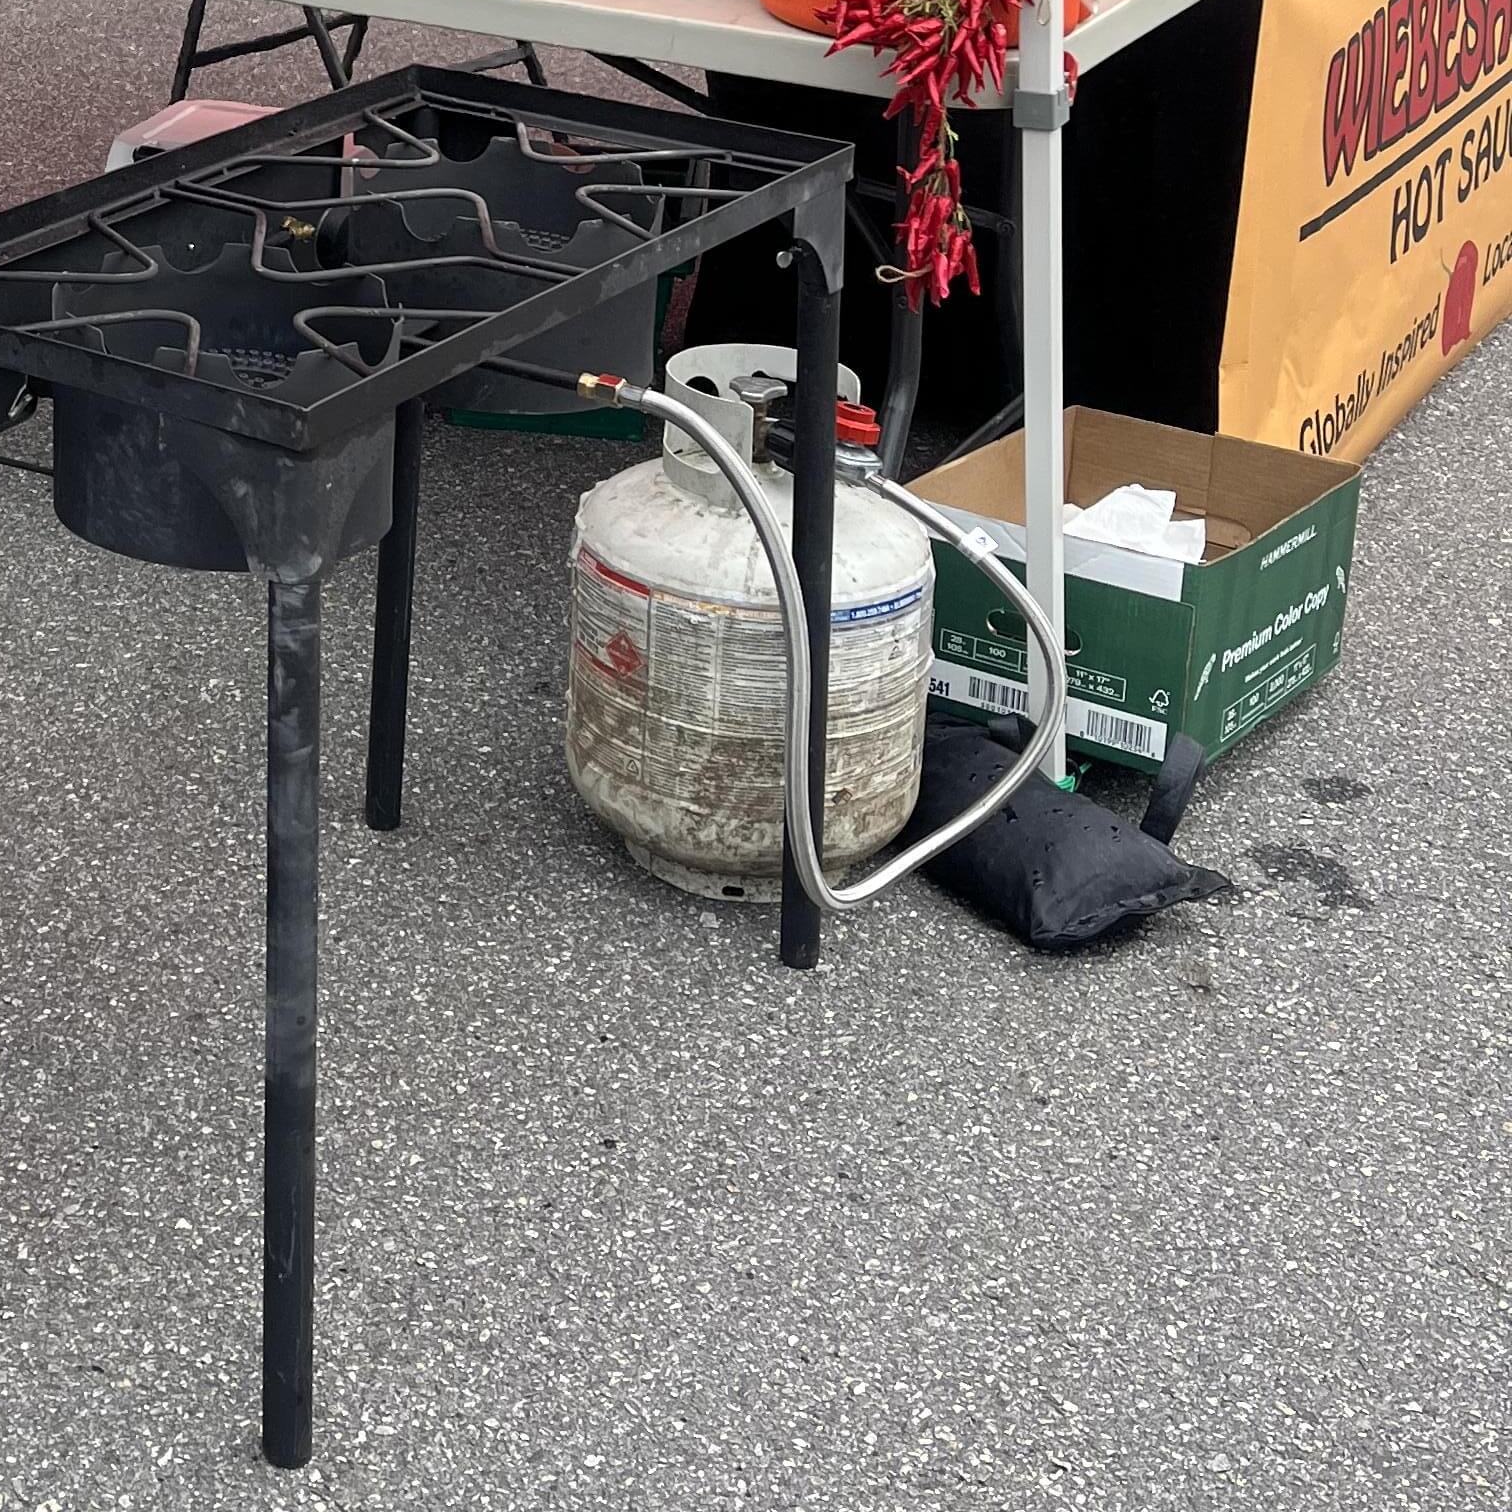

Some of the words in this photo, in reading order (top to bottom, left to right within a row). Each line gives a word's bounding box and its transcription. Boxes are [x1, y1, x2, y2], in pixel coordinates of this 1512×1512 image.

[1390, 147, 1453, 265] HOT
[1457, 98, 1512, 204] SAU
[1299, 369, 1376, 456] Globally
[1376, 292, 1441, 398] Inspired
[1260, 524, 1318, 570] HAMMERMILL
[988, 646, 1007, 658] 100
[1222, 625, 1273, 673] Premium
[1274, 602, 1304, 636] Color
[1304, 583, 1330, 615] Copy
